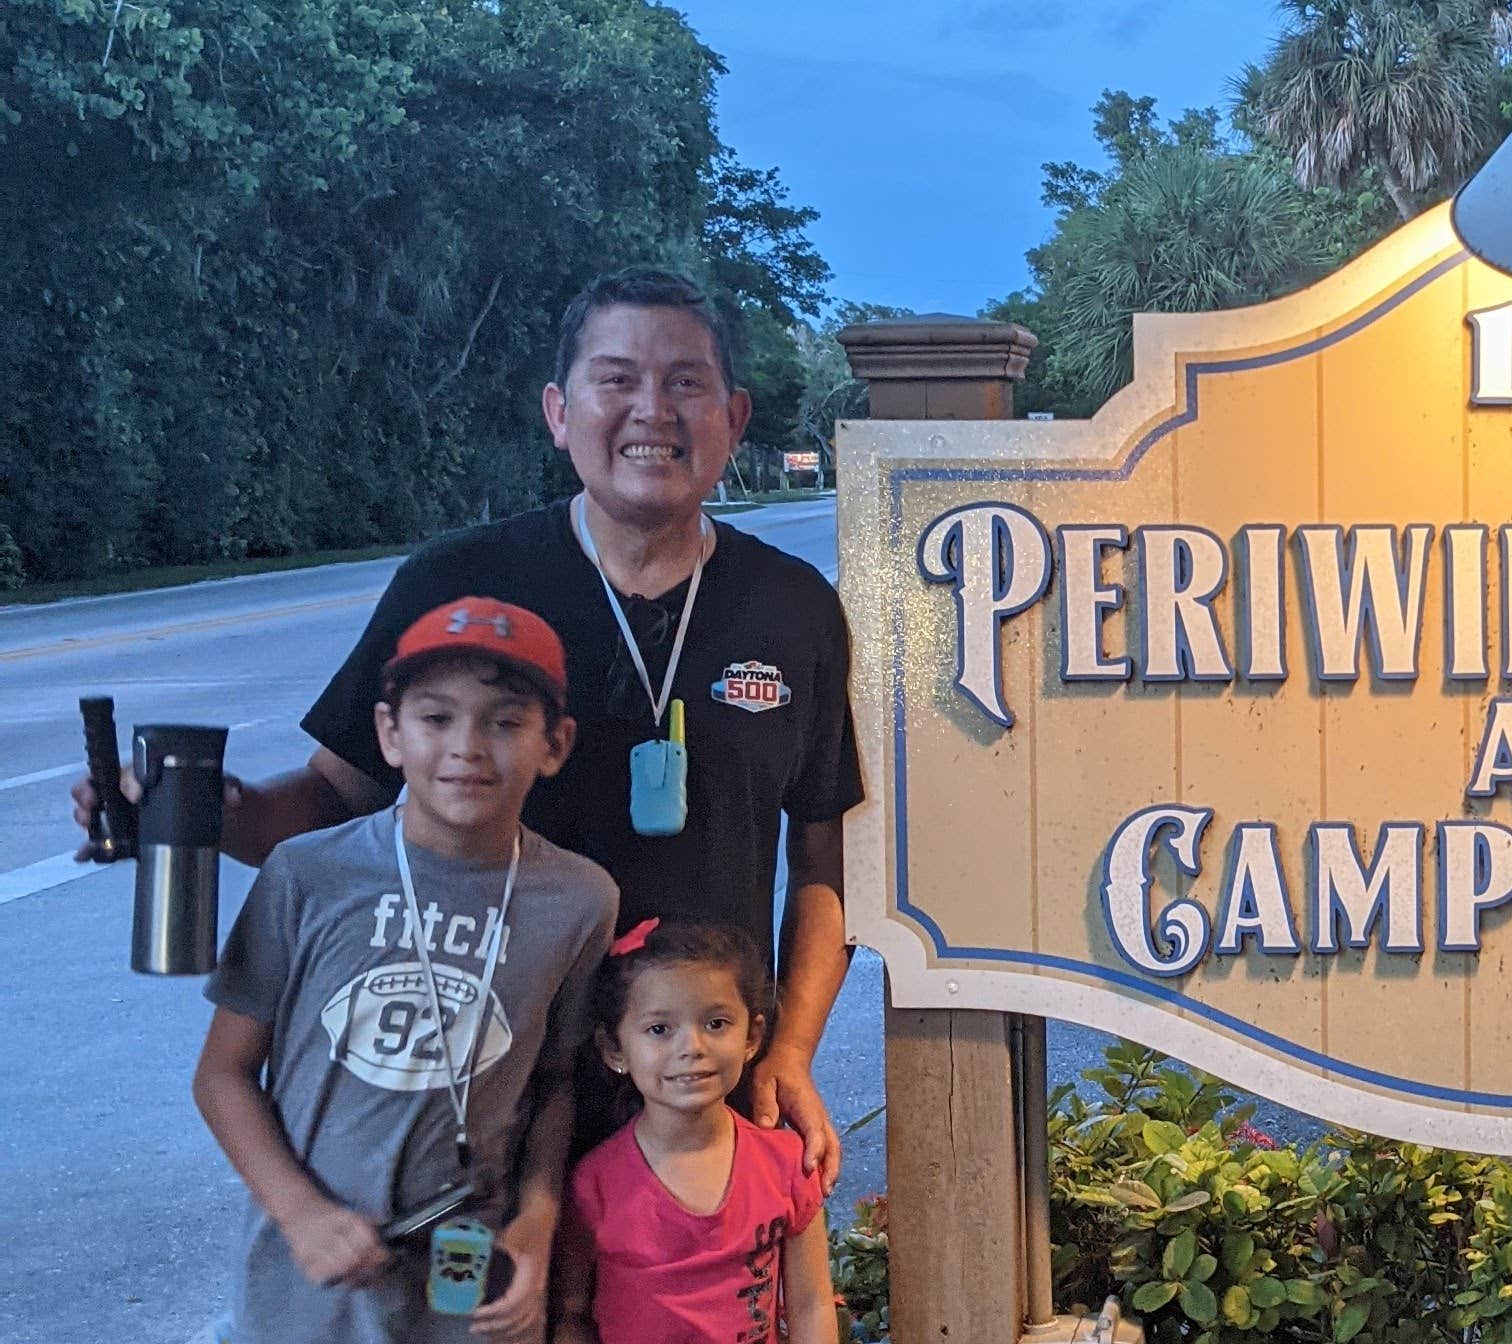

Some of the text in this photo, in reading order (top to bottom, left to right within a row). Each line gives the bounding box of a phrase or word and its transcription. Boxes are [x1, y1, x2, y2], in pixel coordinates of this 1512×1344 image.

[723, 668, 782, 682] DAYTONA
[727, 679, 779, 703] 500
[370, 893, 511, 965] fitch
[373, 1000, 458, 1061] 92
